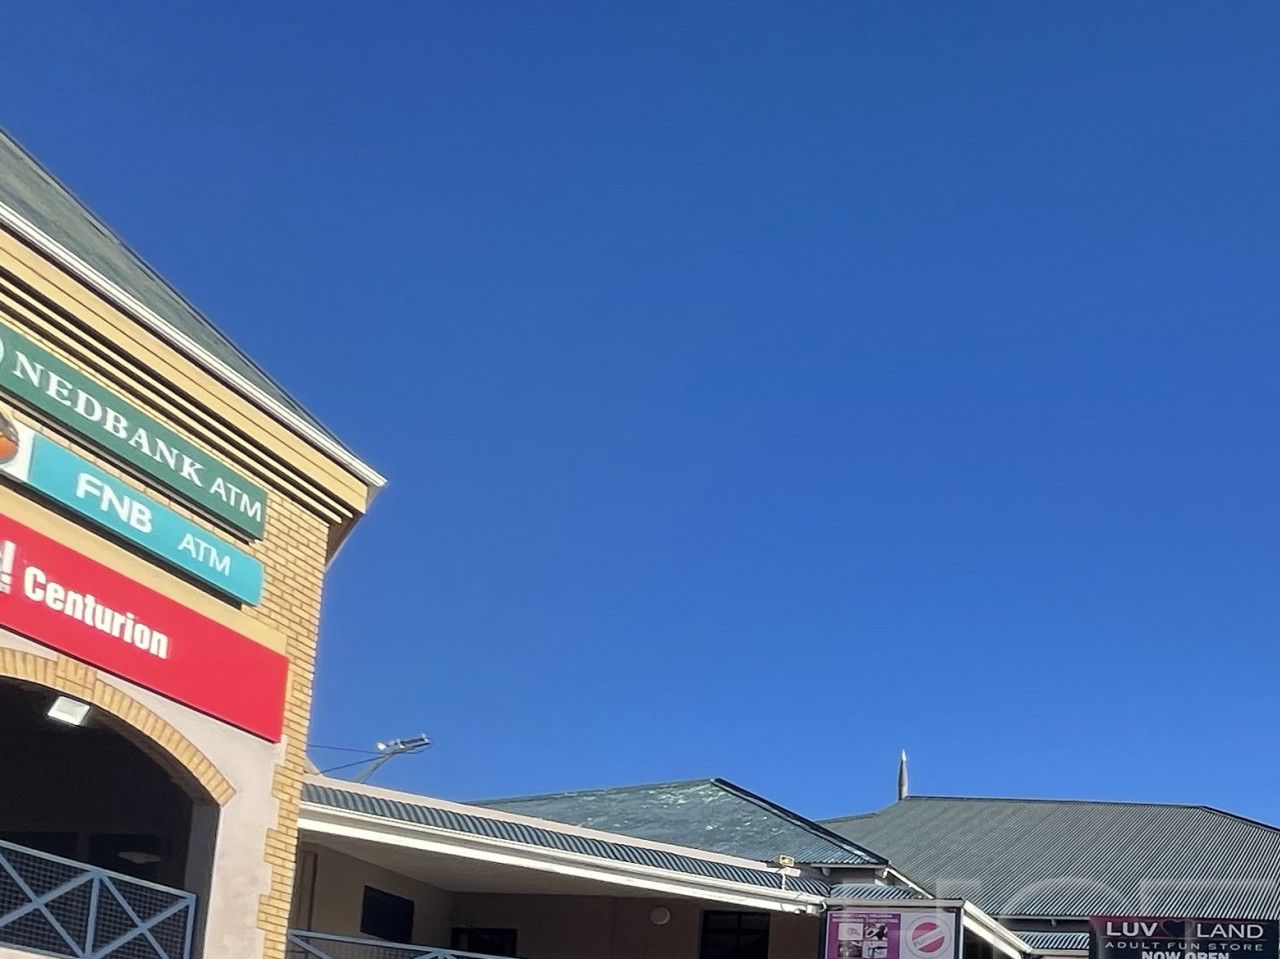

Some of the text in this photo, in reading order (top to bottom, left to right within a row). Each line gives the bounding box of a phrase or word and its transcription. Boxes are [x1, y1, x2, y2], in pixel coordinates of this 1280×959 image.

[14, 350, 262, 524] NEDBANK ATM
[76, 472, 232, 576] FNB ATM
[23, 565, 169, 659] Centurion
[1105, 942, 1264, 951] ADULT FUN STORE
[1106, 921, 1264, 939] LUV LAND
